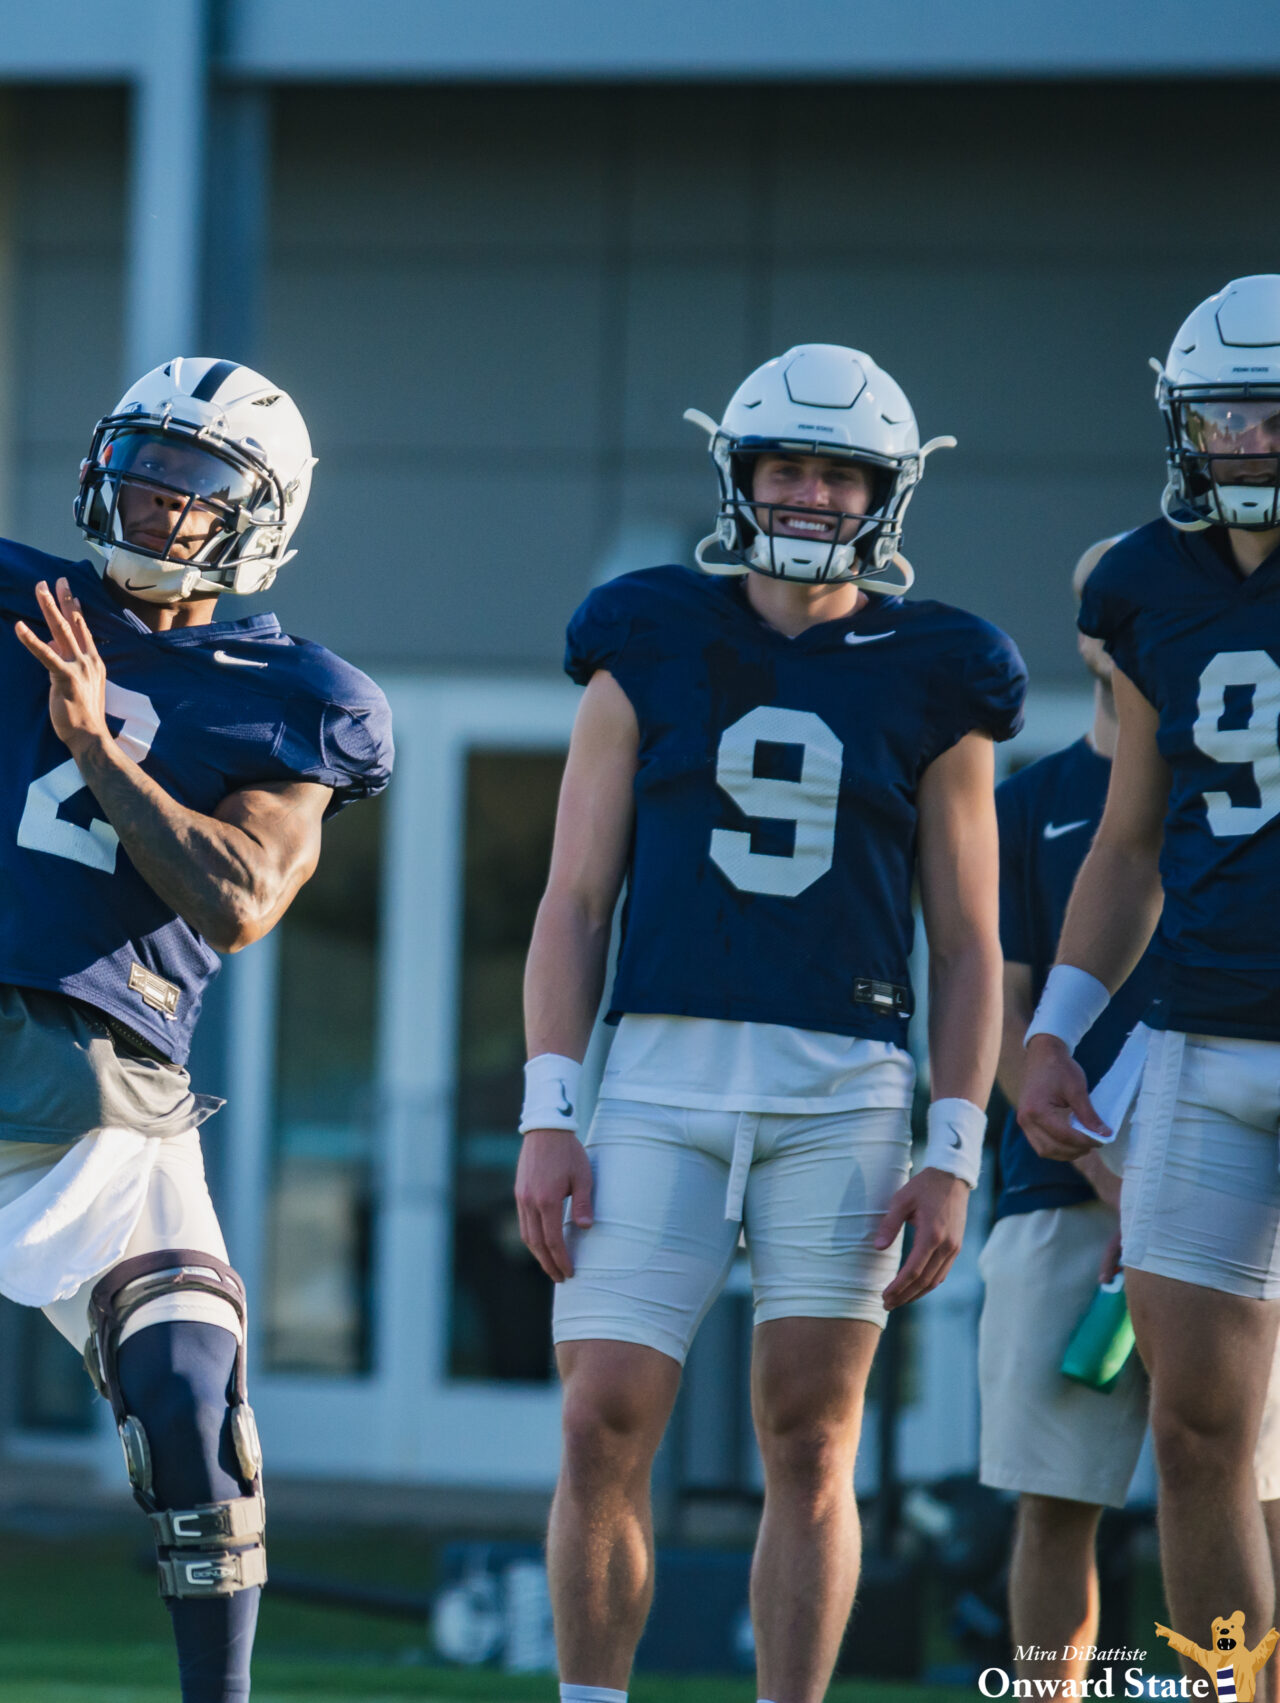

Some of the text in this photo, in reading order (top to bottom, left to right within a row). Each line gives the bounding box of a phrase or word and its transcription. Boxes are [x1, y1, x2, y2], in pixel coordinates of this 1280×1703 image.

[17, 679, 161, 875] 2
[709, 705, 844, 898] 9
[1192, 650, 1280, 837] 9
